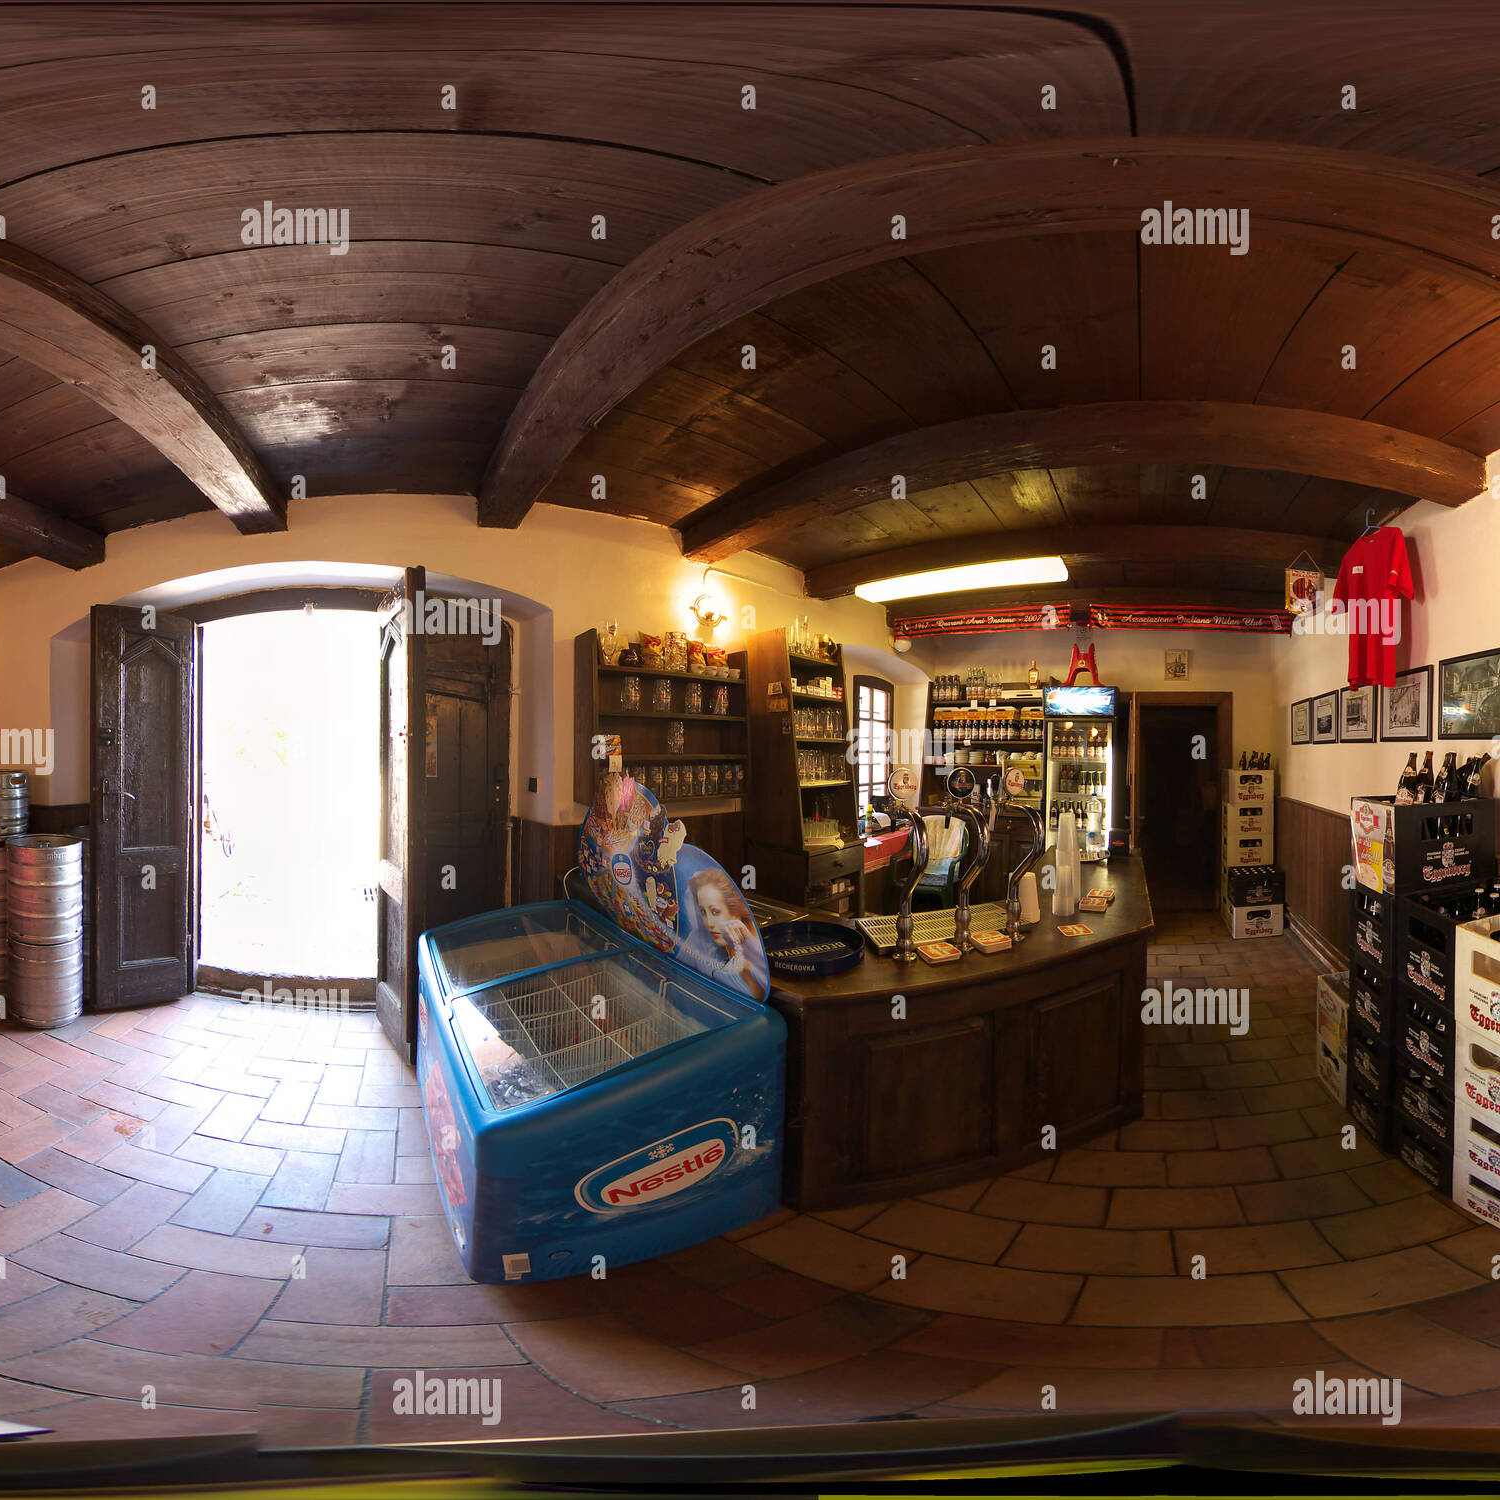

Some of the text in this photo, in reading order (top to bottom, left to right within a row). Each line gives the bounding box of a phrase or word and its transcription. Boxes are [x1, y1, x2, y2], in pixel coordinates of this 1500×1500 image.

[1024, 614, 1043, 622] 2007
[893, 783, 917, 791] Eggenberg
[1238, 792, 1264, 801] Eggenberg
[1423, 863, 1472, 883] Eggenberg
[1245, 927, 1273, 936] Eggenberg
[774, 961, 816, 972] BECHEROVKA
[607, 1143, 724, 1204] Nestlé
